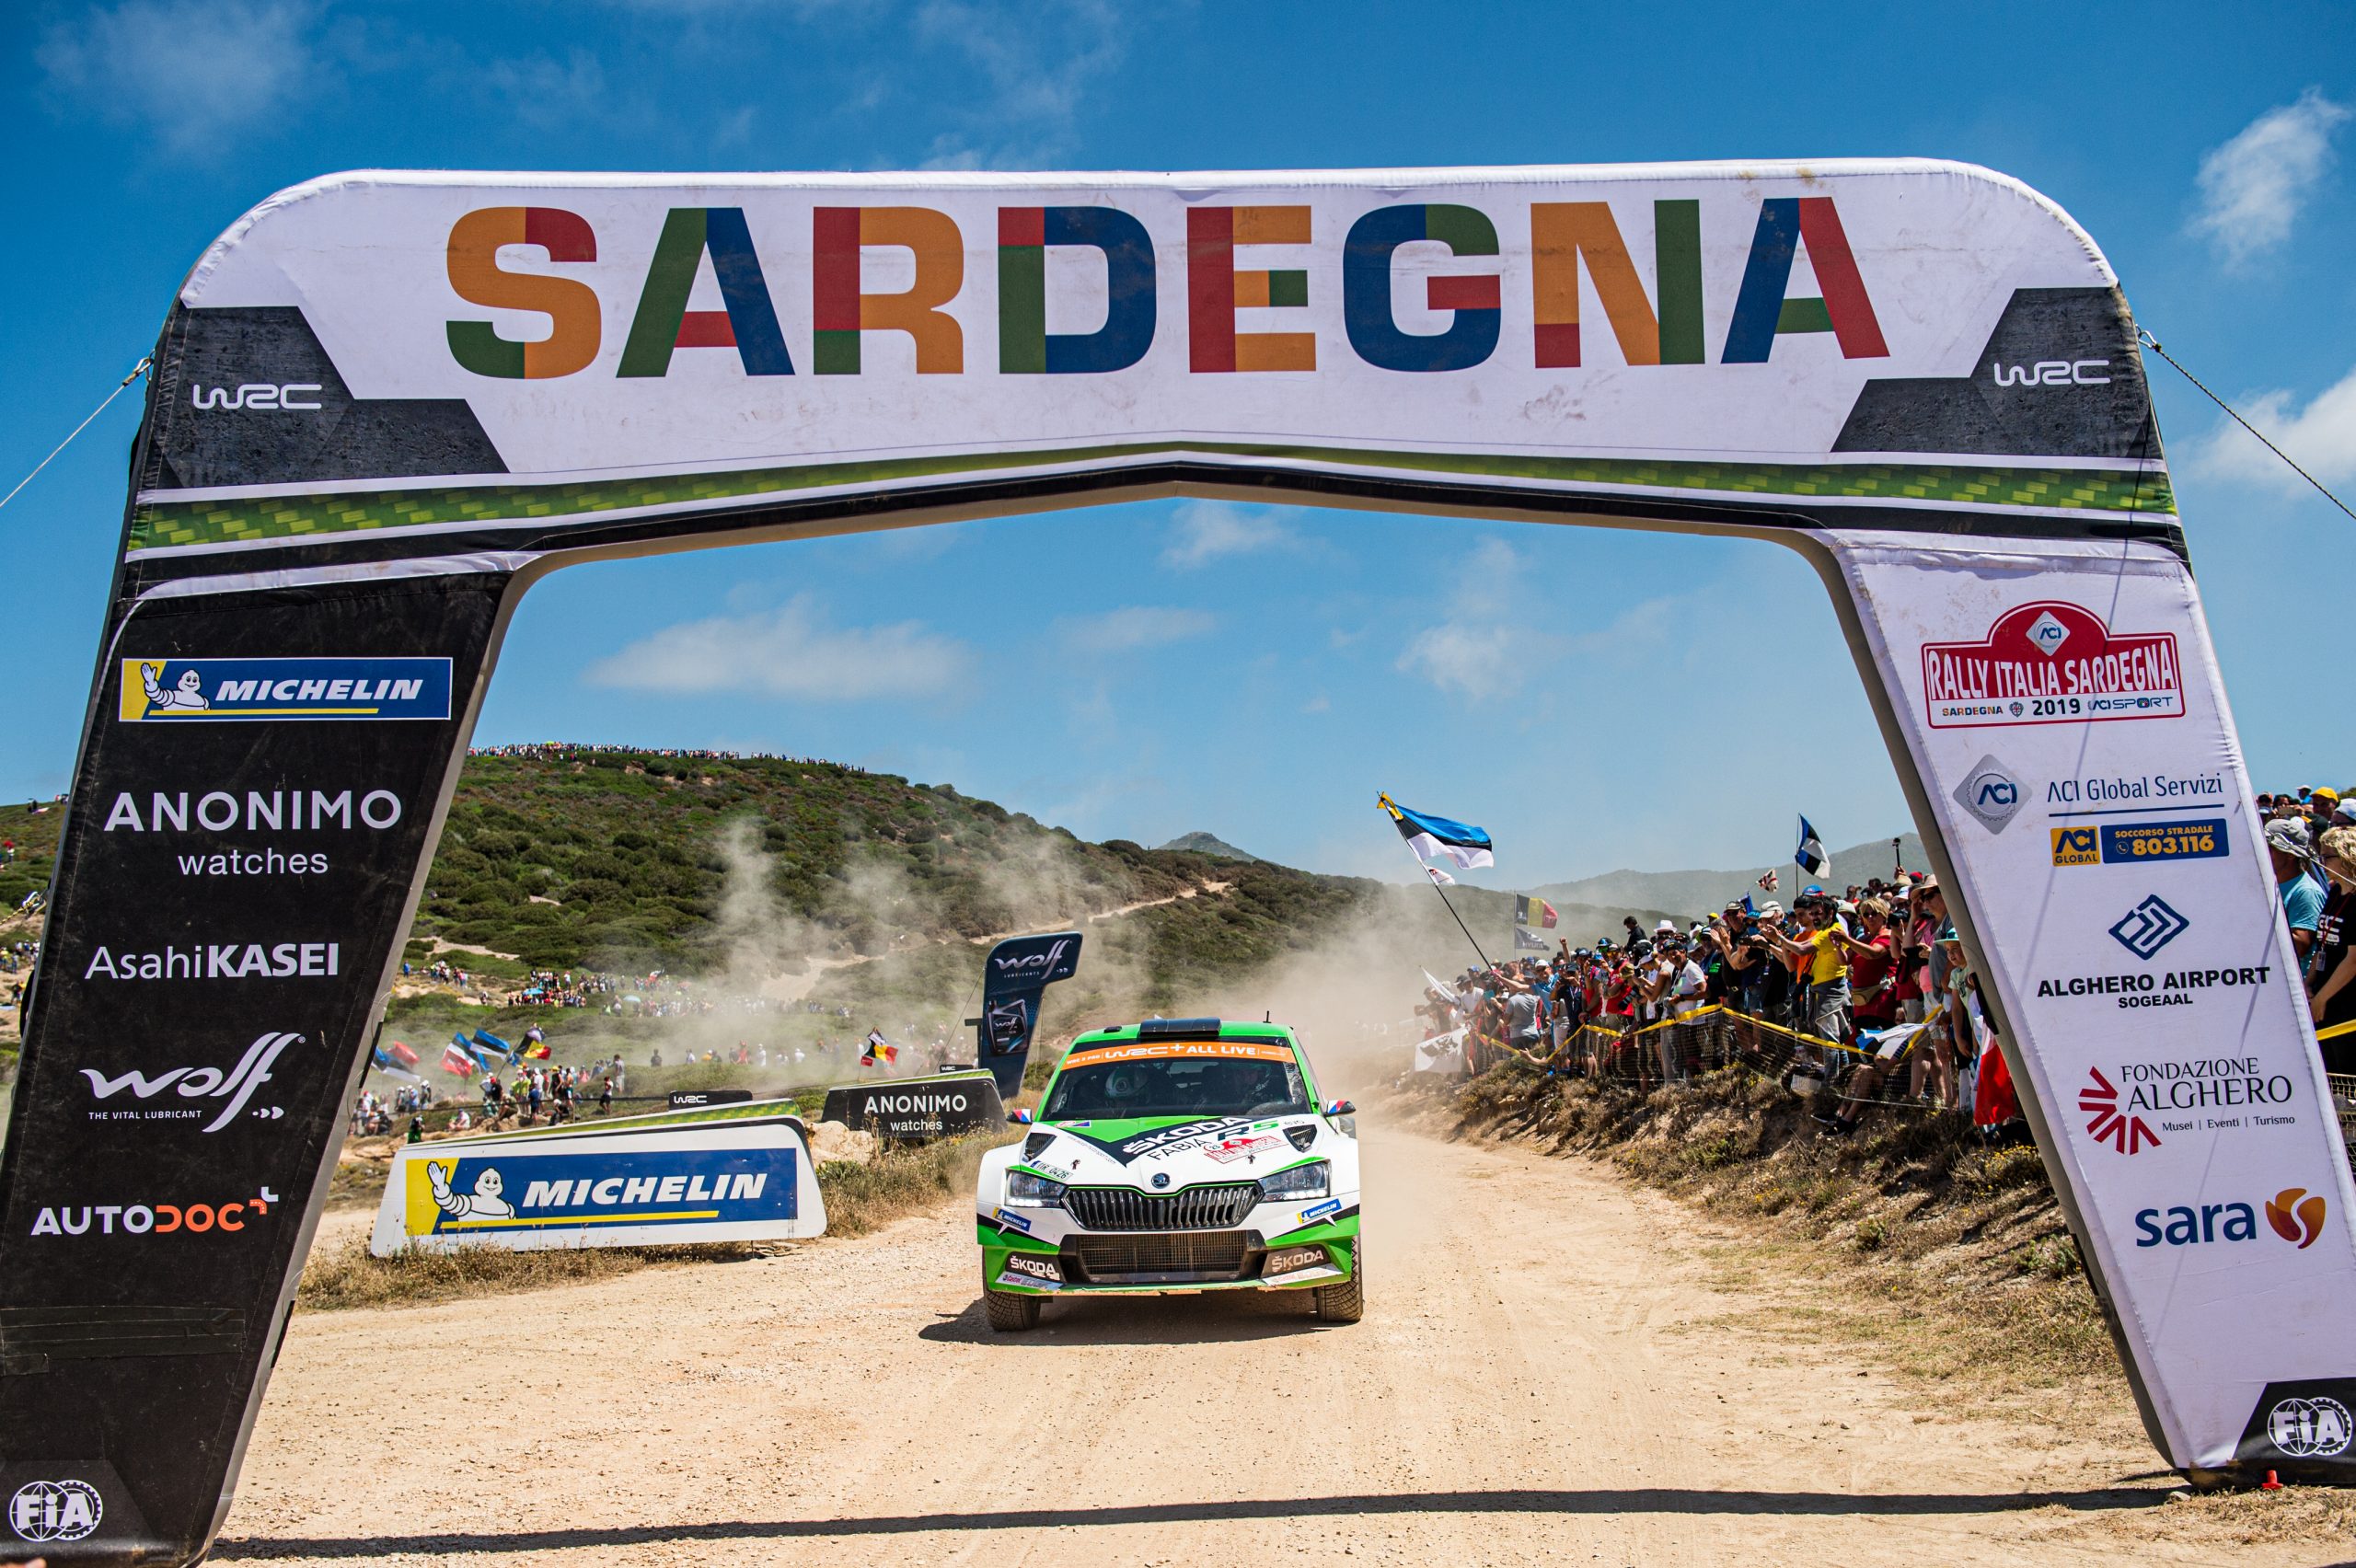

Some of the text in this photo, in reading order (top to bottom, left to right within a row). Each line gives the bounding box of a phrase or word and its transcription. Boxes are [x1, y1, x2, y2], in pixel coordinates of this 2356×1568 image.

[446, 197, 1890, 379] SARDEGNA
[1993, 360, 2111, 387] WRC
[192, 383, 323, 410] WRC
[2039, 627, 2062, 640] ACI
[1928, 640, 2177, 700] RALLY ITALIA SARDEGNA
[215, 678, 423, 702] MICHELIN
[1942, 706, 2004, 717] SARDEGNA
[2032, 698, 2081, 716] 2019
[1979, 783, 2017, 805] ACI
[2048, 773, 2223, 802] ACI Global Servizi
[104, 790, 402, 832] ANONIMO
[2054, 828, 2096, 854] ACI
[2115, 824, 2213, 838] SOCCORSO STRADALE
[2132, 835, 2214, 856] 803.116
[179, 847, 329, 876] watches
[2055, 853, 2098, 864] GLOBAL
[85, 942, 340, 980] AsahiKASEI
[2037, 966, 2270, 997] ALGHERO AIRPORT
[2118, 993, 2193, 1009] SOGEAAL
[1186, 1044, 1217, 1054] ALL
[1221, 1045, 1256, 1055] LIVE
[2120, 1057, 2260, 1083] FONDAZIONE
[674, 1095, 708, 1104] WRC
[863, 1094, 967, 1114] ANONIMO
[2128, 1075, 2292, 1112] ALGHERO
[88, 1110, 202, 1120] THE VITAL LUBRICANT
[890, 1119, 943, 1132] watches
[2163, 1115, 2295, 1132] Musei Eventi Turismo
[1147, 1136, 1214, 1160] FABIA
[522, 1173, 768, 1207] MICHELIN
[31, 1203, 245, 1236] AUTODOC
[2136, 1202, 2257, 1248] sara
